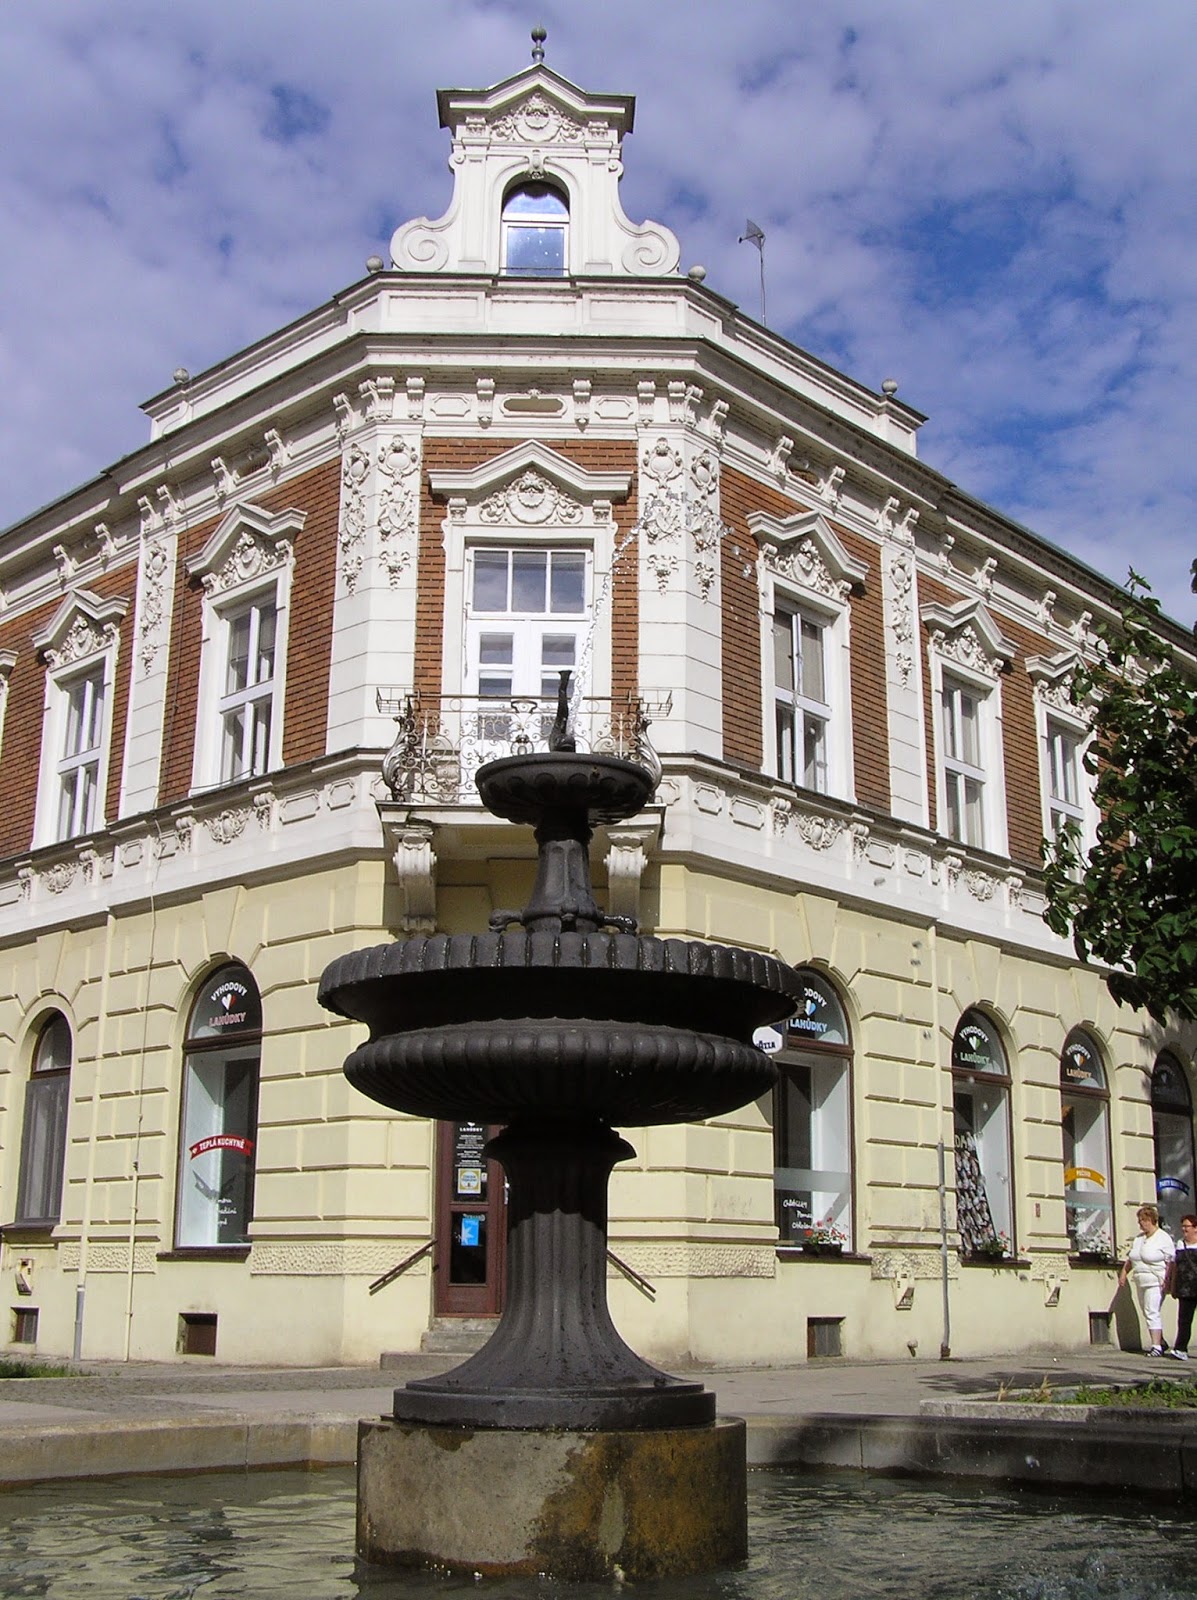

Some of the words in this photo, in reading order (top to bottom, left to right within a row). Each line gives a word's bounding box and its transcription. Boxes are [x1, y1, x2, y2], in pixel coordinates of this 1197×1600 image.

[210, 981, 248, 1001] VYHODOVY
[804, 987, 827, 1007] ODOVY
[790, 1017, 828, 1032] LAHŮDKY
[199, 1137, 217, 1151] TEPLÁ
